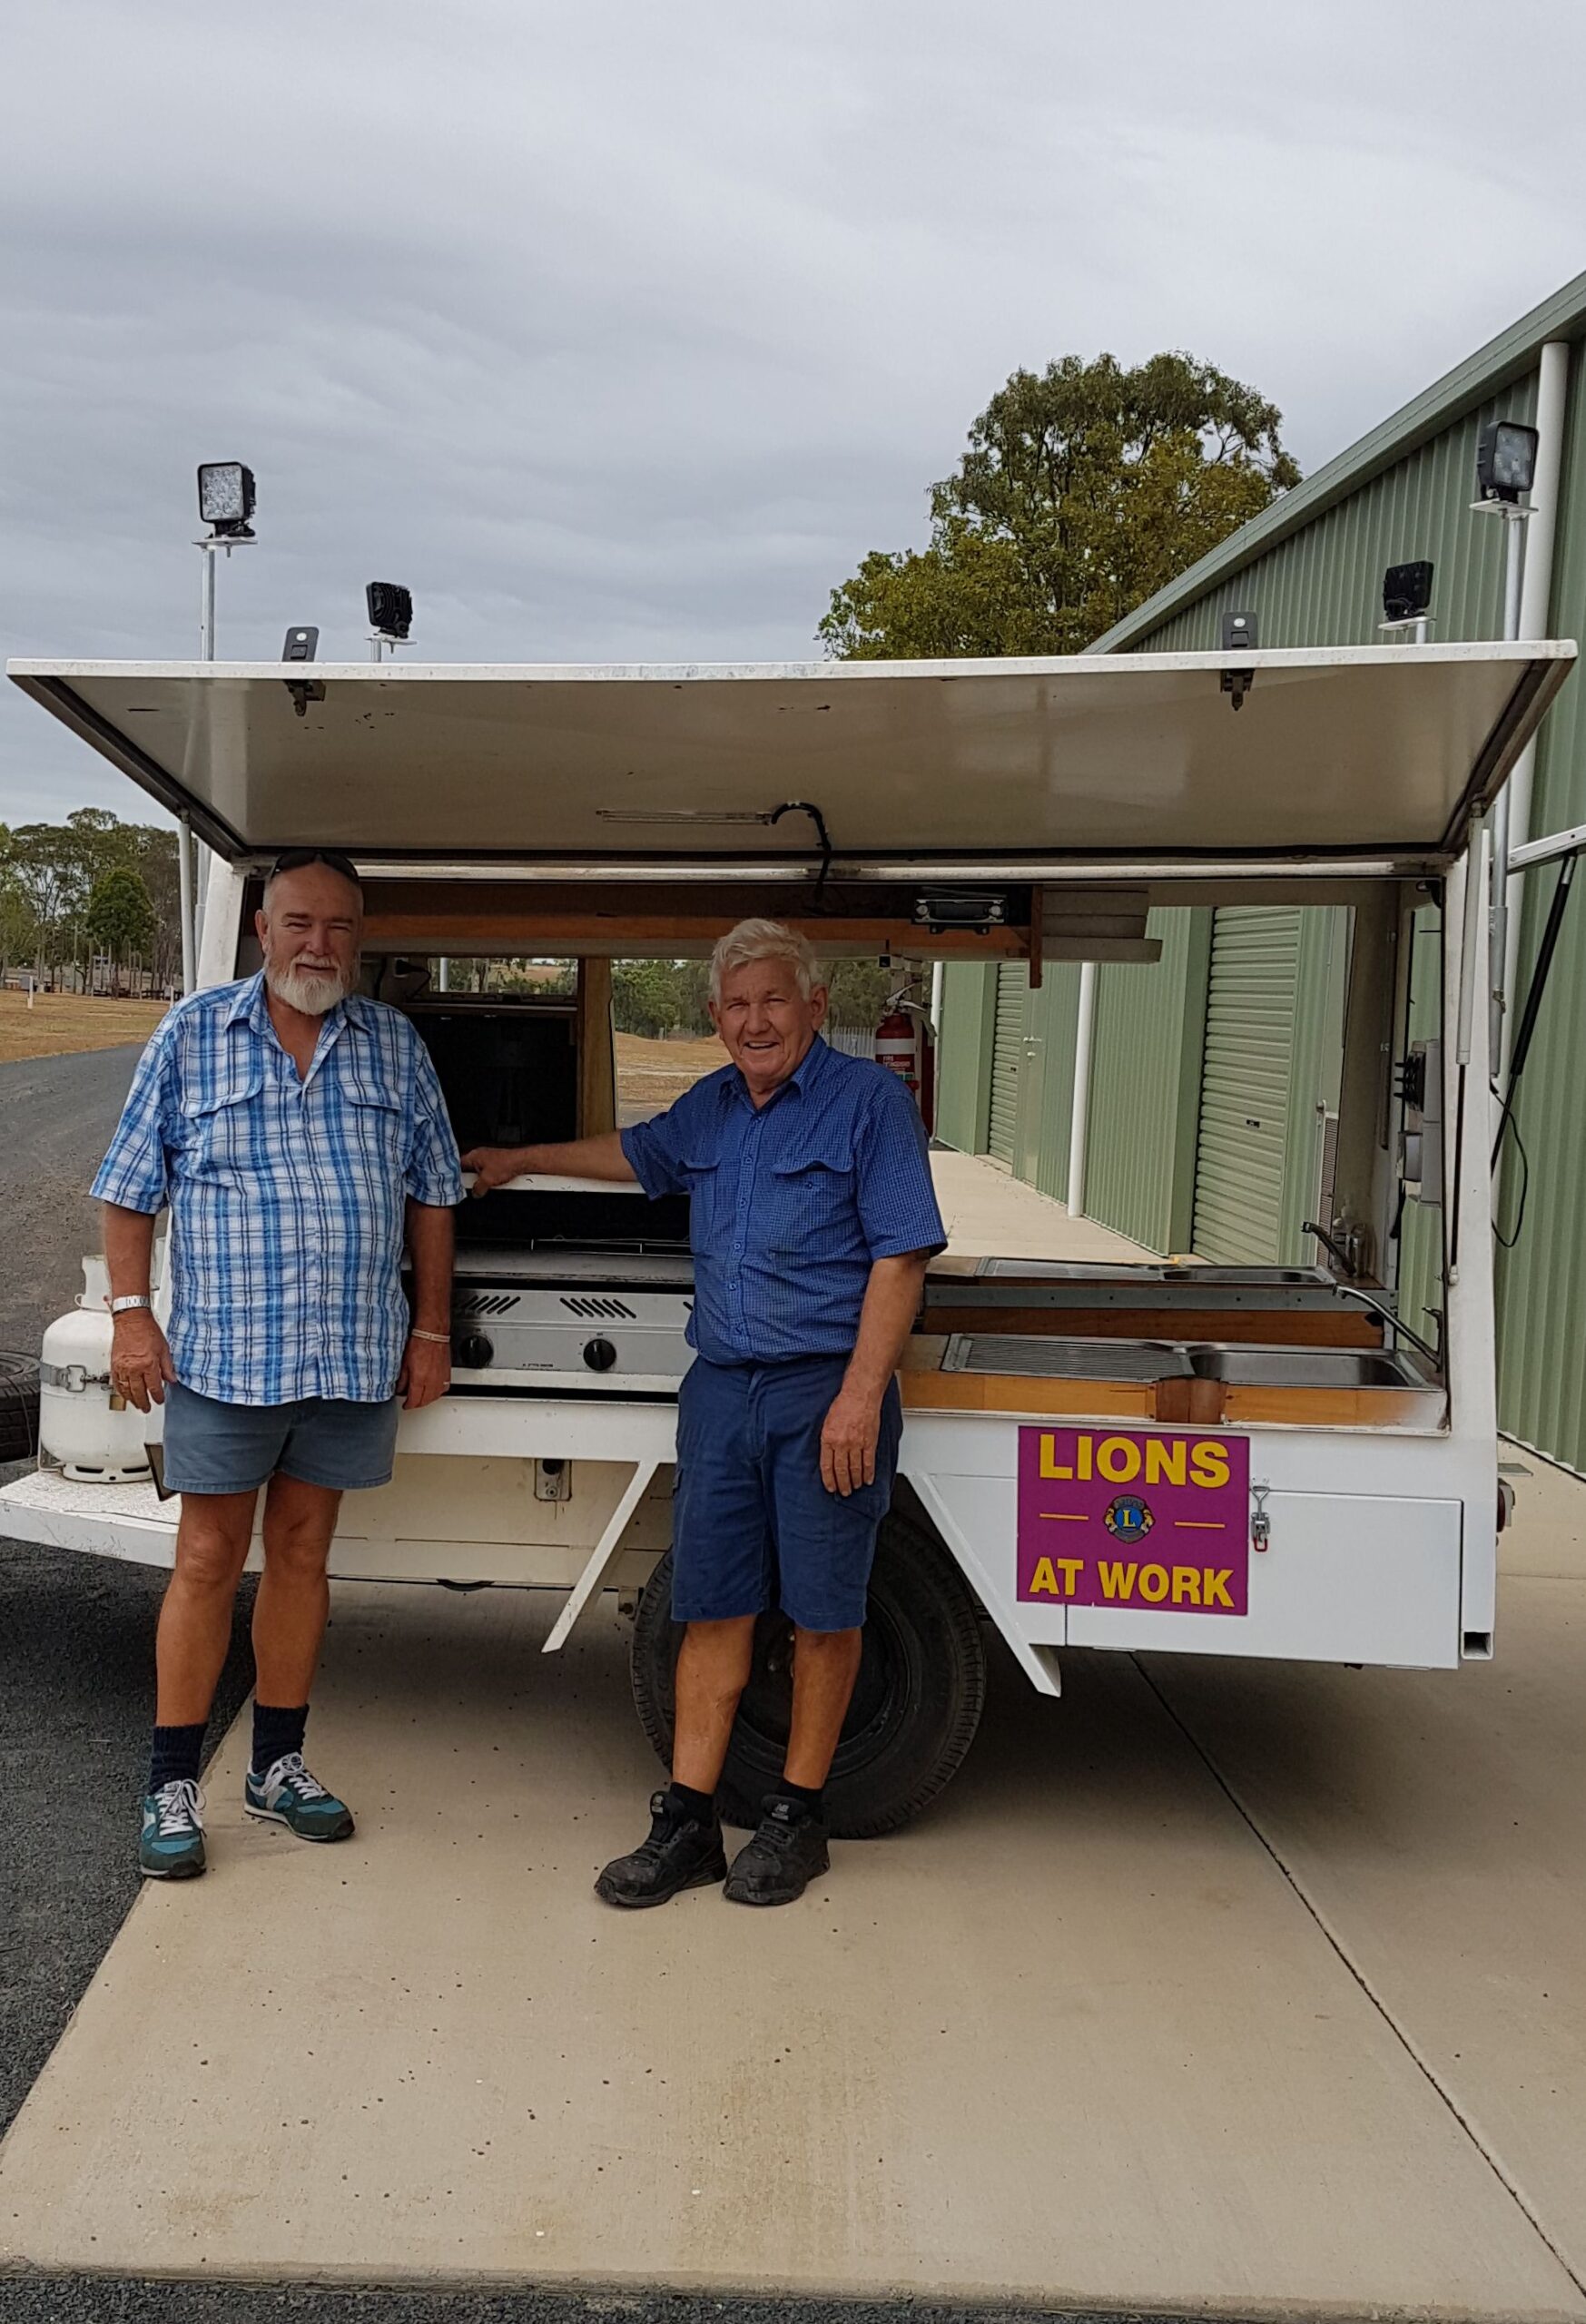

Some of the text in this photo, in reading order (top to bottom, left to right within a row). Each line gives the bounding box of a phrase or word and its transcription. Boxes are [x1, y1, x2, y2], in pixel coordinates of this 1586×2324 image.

[1039, 1433, 1231, 1489] LIONS
[1122, 1509, 1136, 1527] L
[1029, 1556, 1236, 1608] AT WORK
